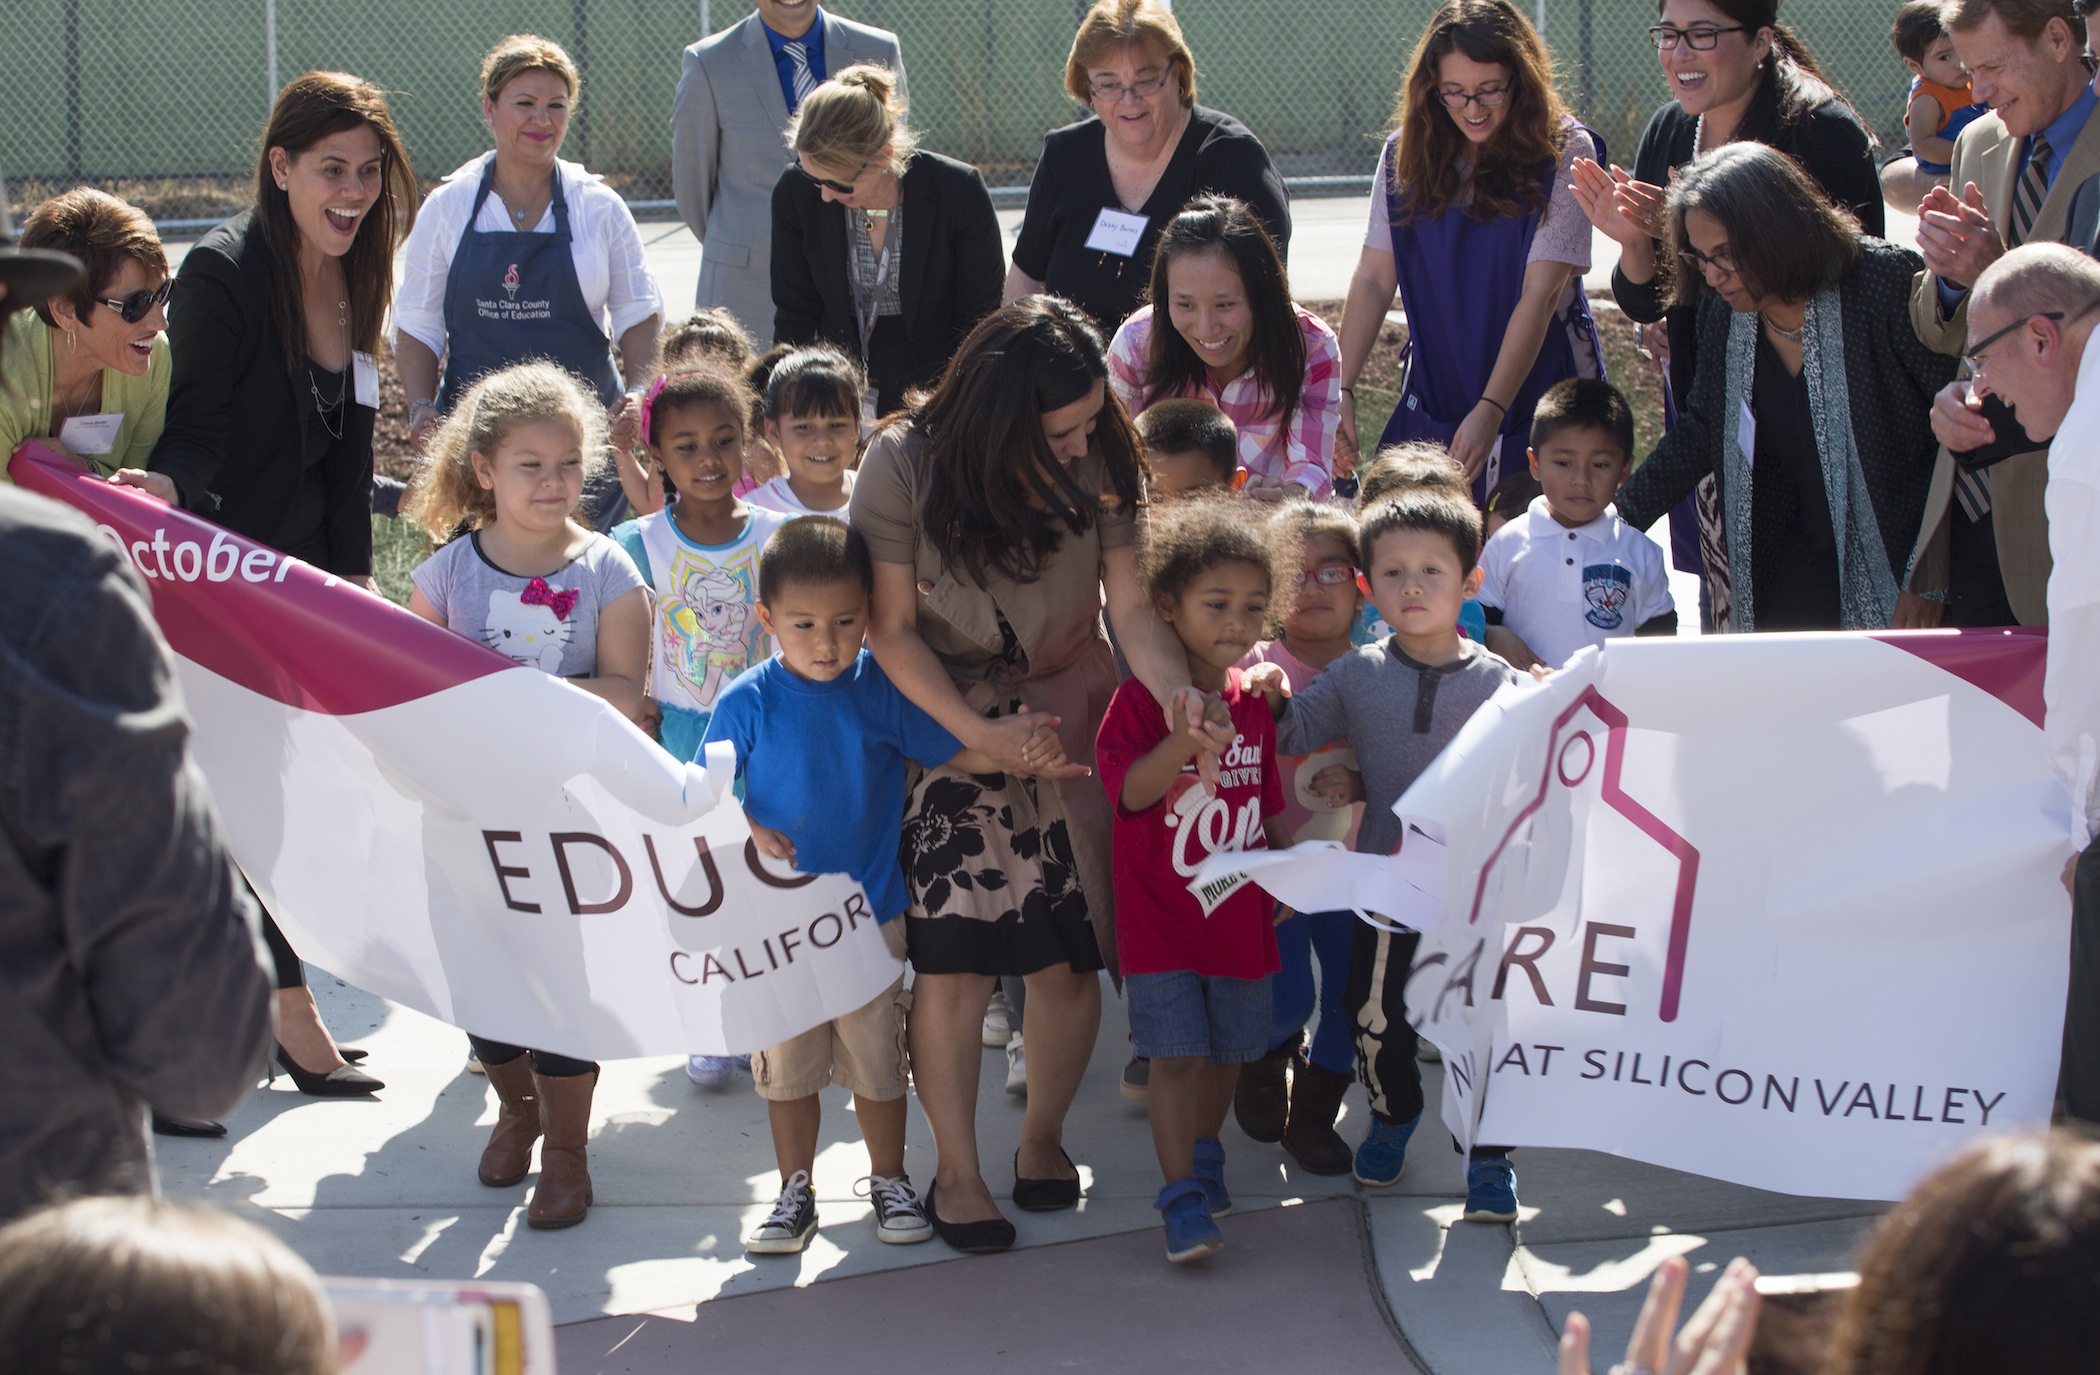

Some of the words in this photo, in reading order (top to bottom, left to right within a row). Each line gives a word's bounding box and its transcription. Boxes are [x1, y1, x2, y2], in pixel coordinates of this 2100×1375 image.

[476, 298, 498, 309] Santa
[498, 300, 520, 310] Clara
[522, 300, 550, 310] County
[477, 308, 500, 319] Office
[501, 310, 509, 319] of
[511, 310, 551, 320] Education
[669, 891, 873, 986] CALIFOR
[1494, 1042, 1565, 1077] AT
[1579, 1048, 1800, 1113] SILICON
[1814, 1078, 2007, 1126] VALLEY
